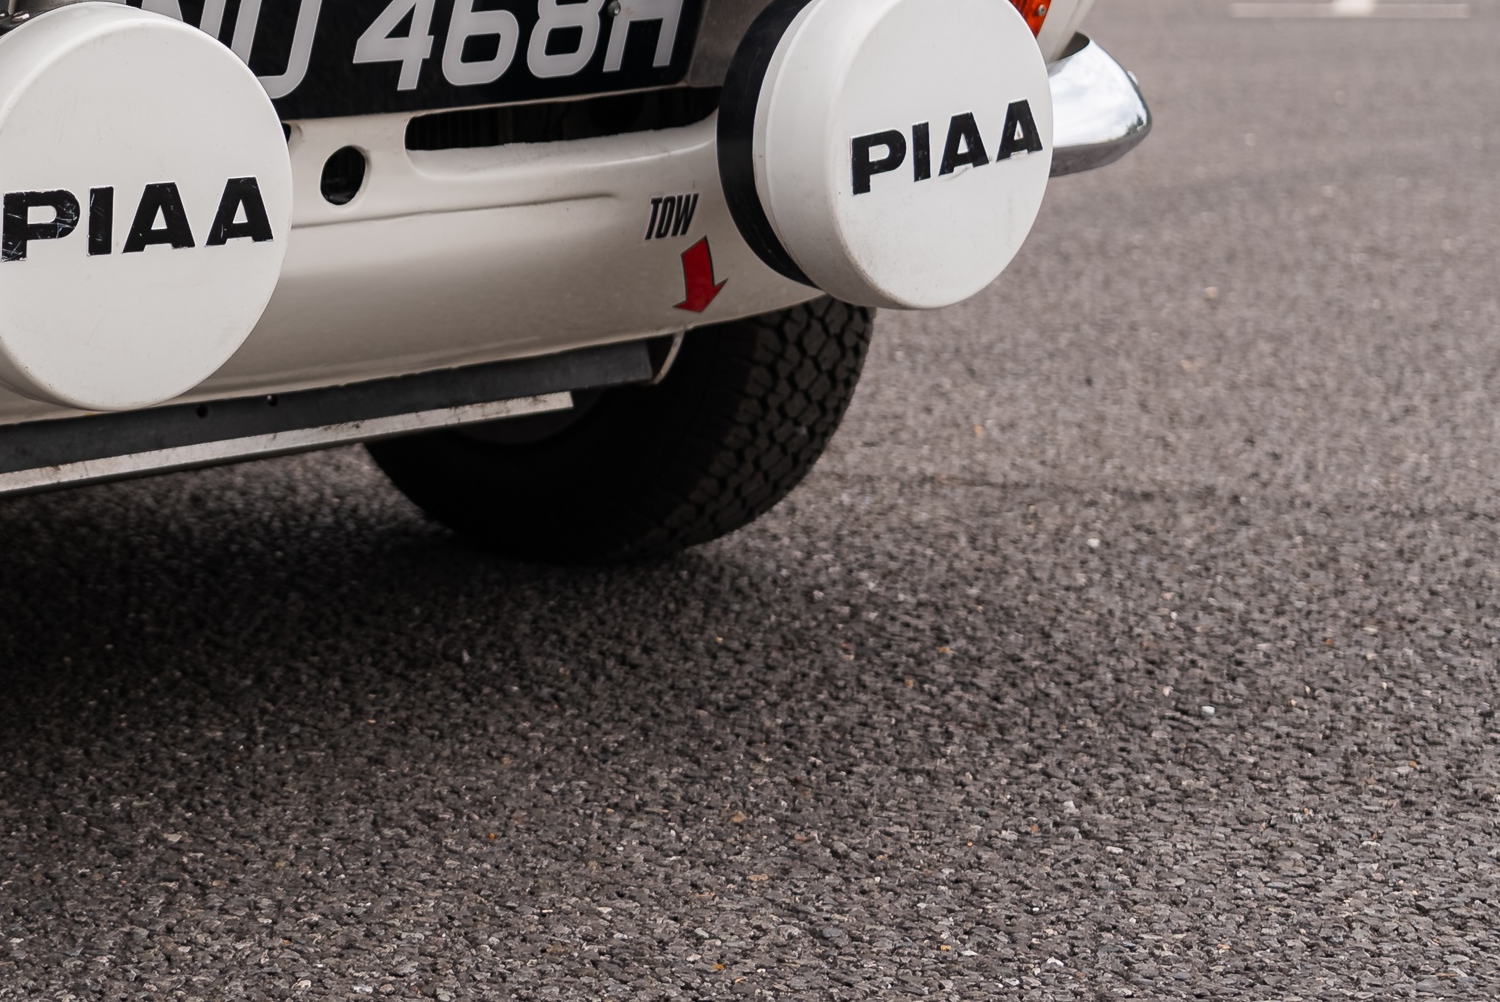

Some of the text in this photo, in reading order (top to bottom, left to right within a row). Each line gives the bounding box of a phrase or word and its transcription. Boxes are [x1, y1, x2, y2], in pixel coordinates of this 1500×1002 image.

[850, 99, 1043, 196] PIAA
[1, 176, 275, 263] PIAA
[644, 192, 700, 240] TOW
